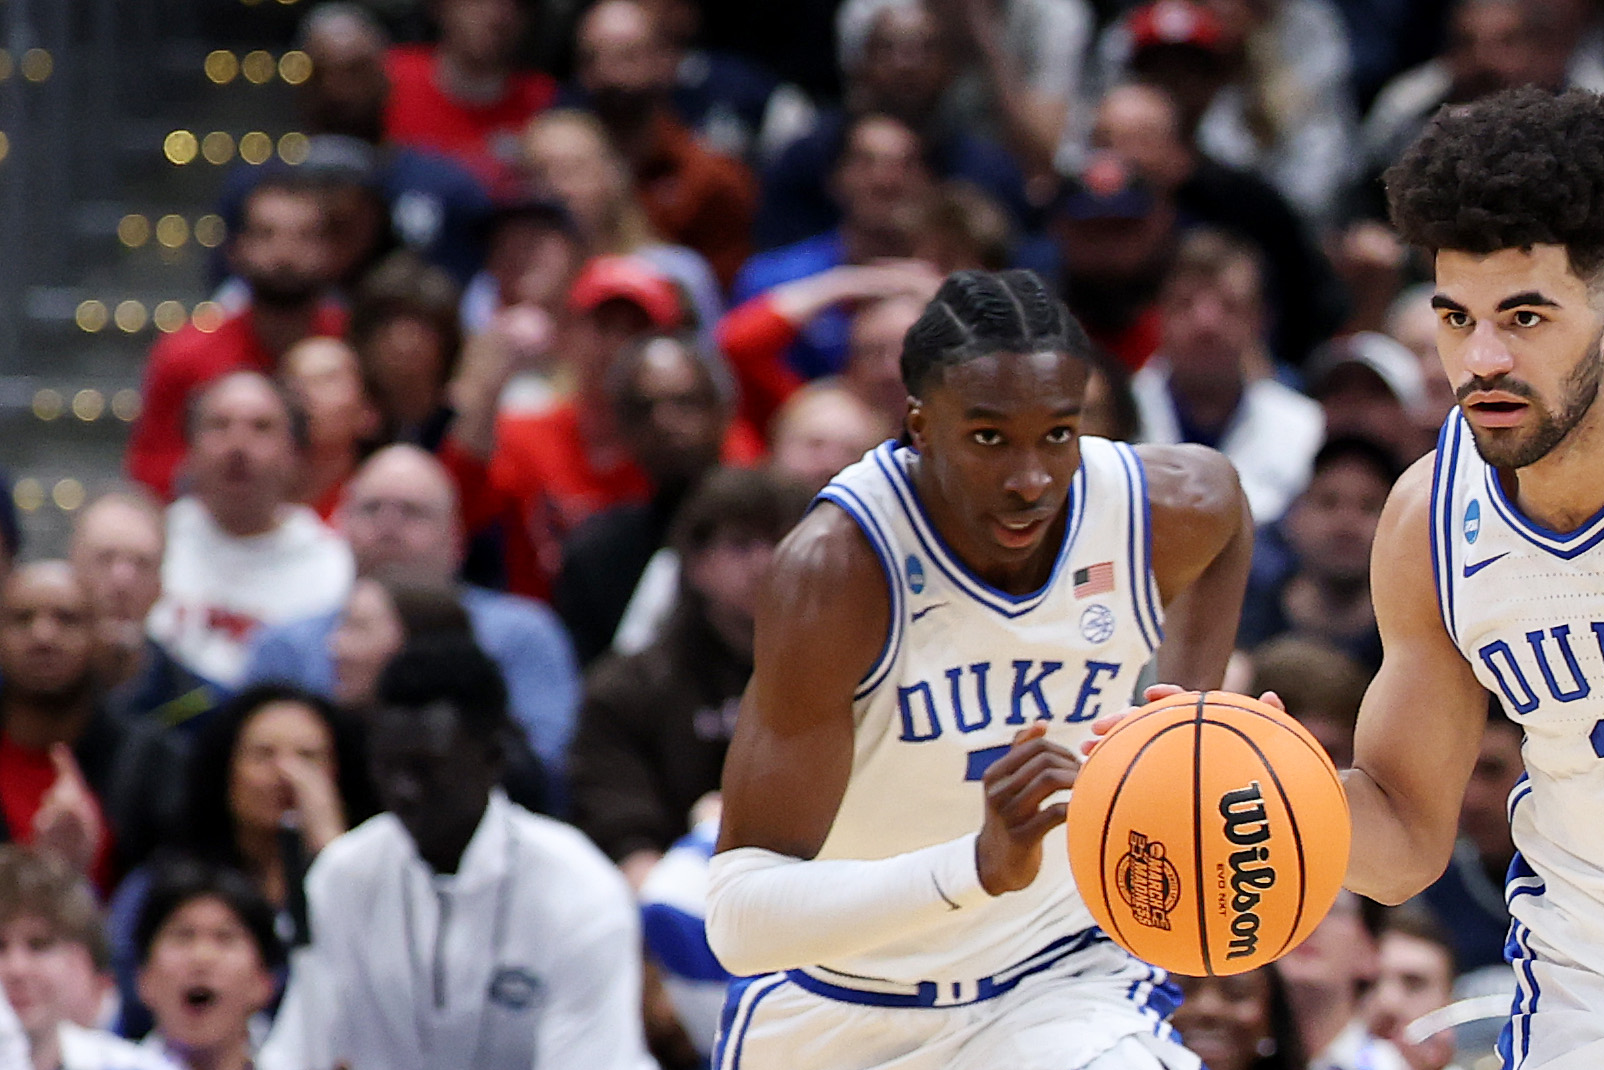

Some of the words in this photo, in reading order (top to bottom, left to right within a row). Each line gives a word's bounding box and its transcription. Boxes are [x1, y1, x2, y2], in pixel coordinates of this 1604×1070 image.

[897, 660, 1121, 742] DUKE
[1133, 858, 1153, 927] MADNESS
[1147, 857, 1164, 910] MARCH
[1216, 863, 1226, 889] EVO
[1219, 780, 1276, 961] Wilson
[1217, 892, 1227, 917] NXT
